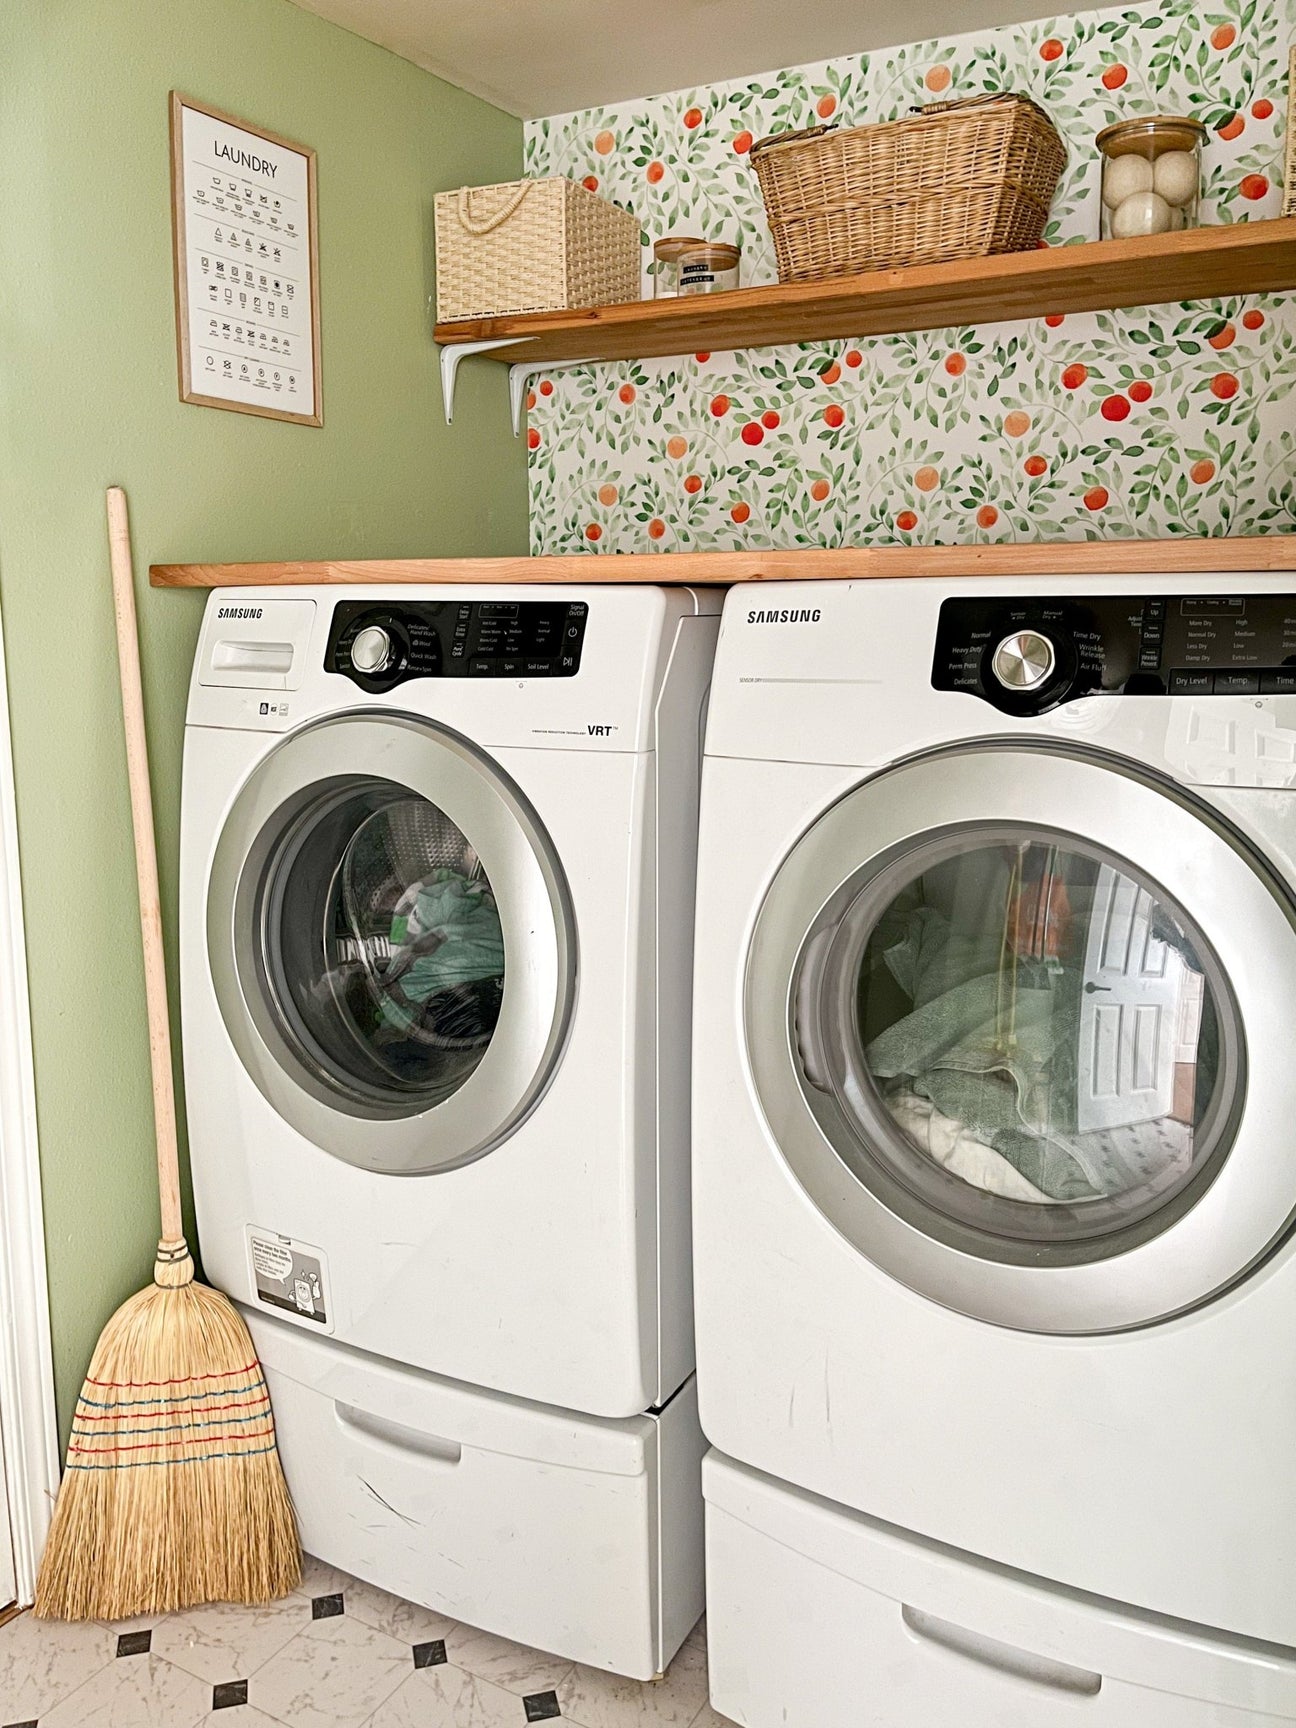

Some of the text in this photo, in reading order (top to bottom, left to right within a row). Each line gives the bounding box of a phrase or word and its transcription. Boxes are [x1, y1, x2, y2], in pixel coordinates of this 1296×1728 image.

[214, 140, 278, 178] LAUNDRY
[217, 607, 263, 619] SAMSUNG
[747, 609, 821, 624] SAMSUNG
[1089, 632, 1101, 641] Dry
[952, 646, 969, 654] Heavy
[1079, 643, 1104, 651] Wrinkle
[1080, 651, 1105, 659] Release
[1091, 663, 1107, 671] Fluff
[954, 677, 978, 685] Delicates
[1176, 676, 1208, 687] Dry Level
[1276, 676, 1295, 685] Time
